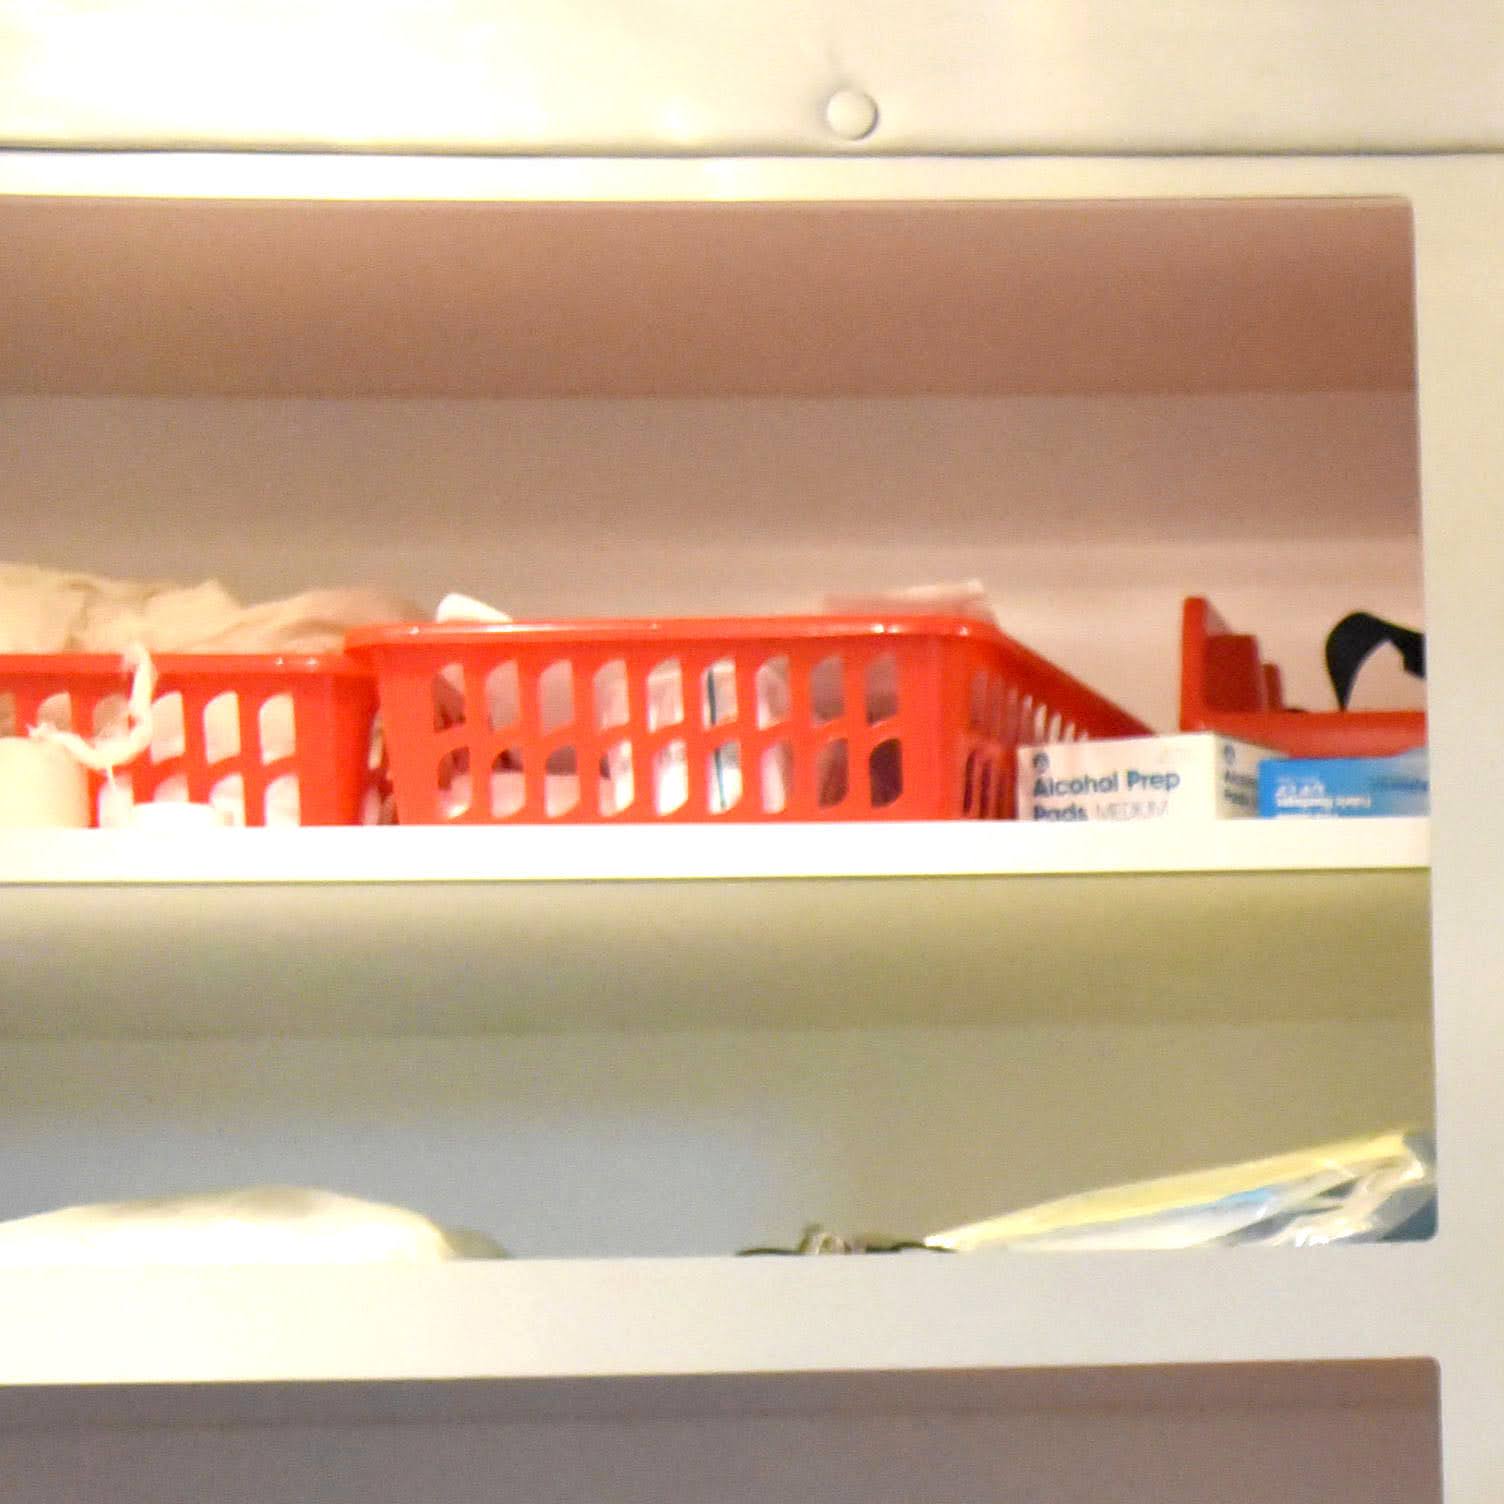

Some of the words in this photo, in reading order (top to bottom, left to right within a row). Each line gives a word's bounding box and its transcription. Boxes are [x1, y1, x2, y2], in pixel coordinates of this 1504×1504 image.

[1033, 773, 1119, 798] Alcohol
[1127, 769, 1181, 795] Prep
[1033, 801, 1088, 821] Pads
